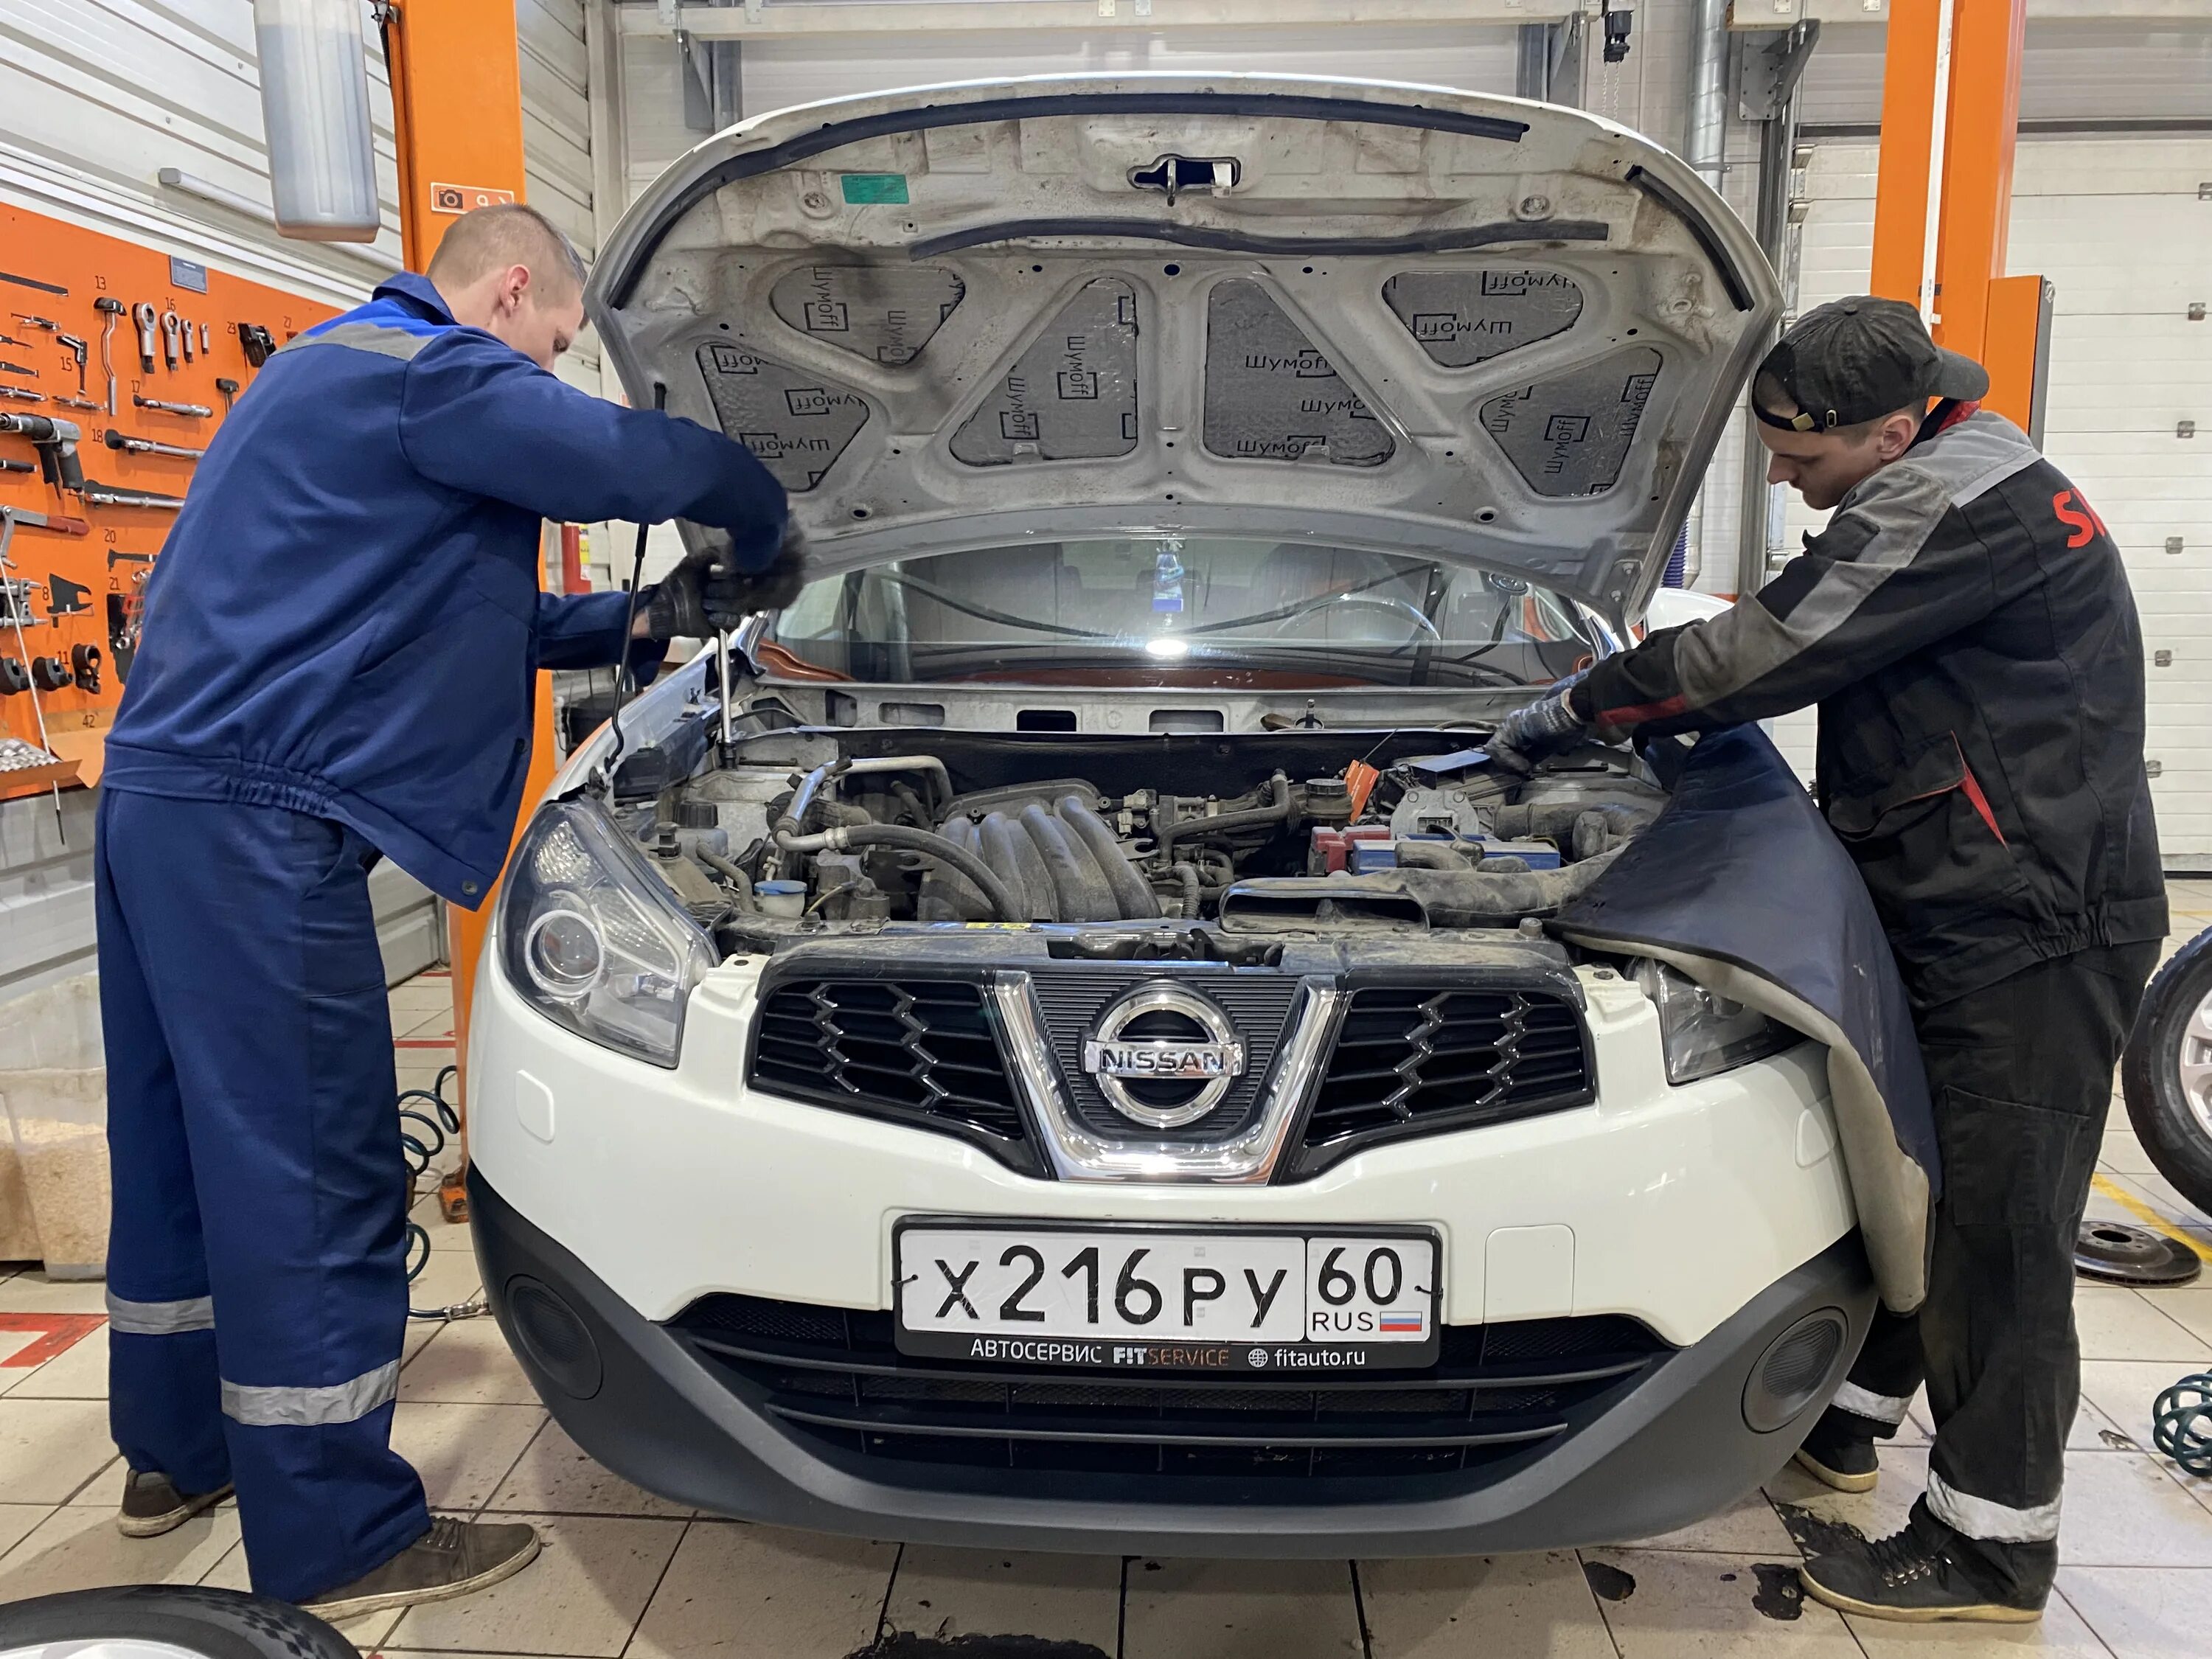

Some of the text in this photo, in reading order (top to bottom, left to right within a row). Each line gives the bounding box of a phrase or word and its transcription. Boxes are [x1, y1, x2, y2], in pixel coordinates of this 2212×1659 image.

[94, 275, 107, 291] 13
[165, 296, 176, 311] 16
[60, 356, 72, 372] 15
[1063, 335, 1089, 395] Шумоff
[131, 380, 141, 394] 17
[1006, 376, 1032, 437] Шумоff
[91, 428, 102, 443] 18
[1544, 418, 1577, 474] Шумоff
[104, 529, 116, 543] 20
[108, 577, 120, 591] 21
[41, 585, 50, 601] 8
[56, 650, 69, 665] 11
[82, 714, 96, 728] 42
[1101, 1048, 1225, 1074] NISSAN
[1312, 1311, 1374, 1332] RUS
[970, 1338, 1102, 1364] АВТОСЕРВИС
[1274, 1348, 1366, 1367] fitauto.ru
